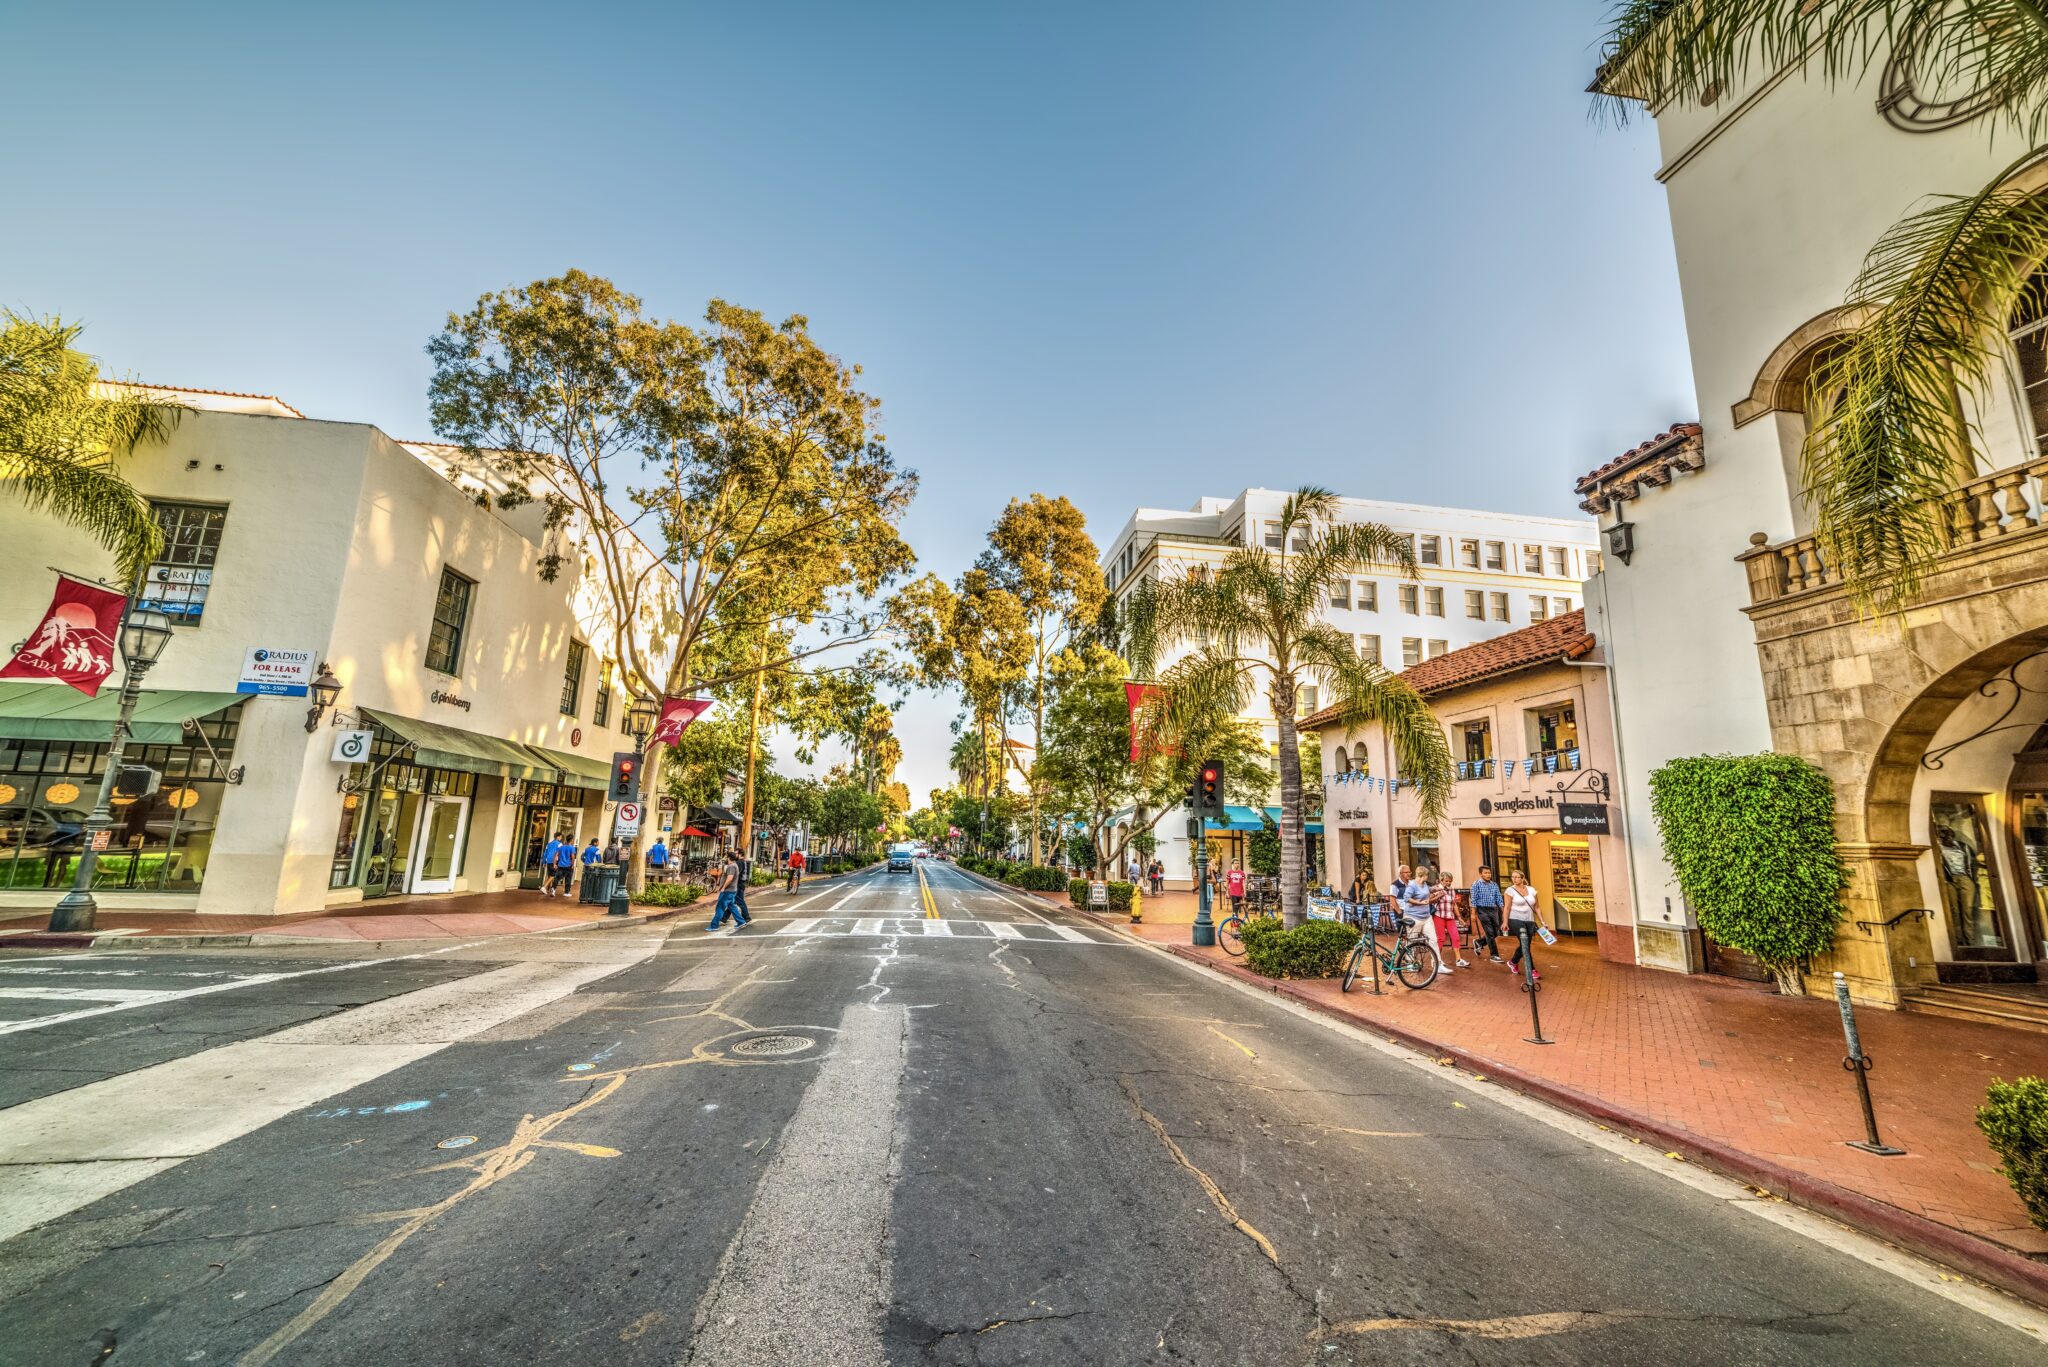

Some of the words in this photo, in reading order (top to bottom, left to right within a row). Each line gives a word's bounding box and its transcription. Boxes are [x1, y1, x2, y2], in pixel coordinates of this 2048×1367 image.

[172, 570, 210, 581] RADUS
[268, 651, 308, 661] RADIUS
[17, 653, 58, 672] CADA
[274, 665, 301, 673] LEASE
[438, 692, 471, 712] pinkberry
[1494, 797, 1535, 813] sunglass
[1535, 796, 1554, 808] hut
[1572, 816, 1596, 825] sunglass
[1596, 816, 1606, 824] hut
